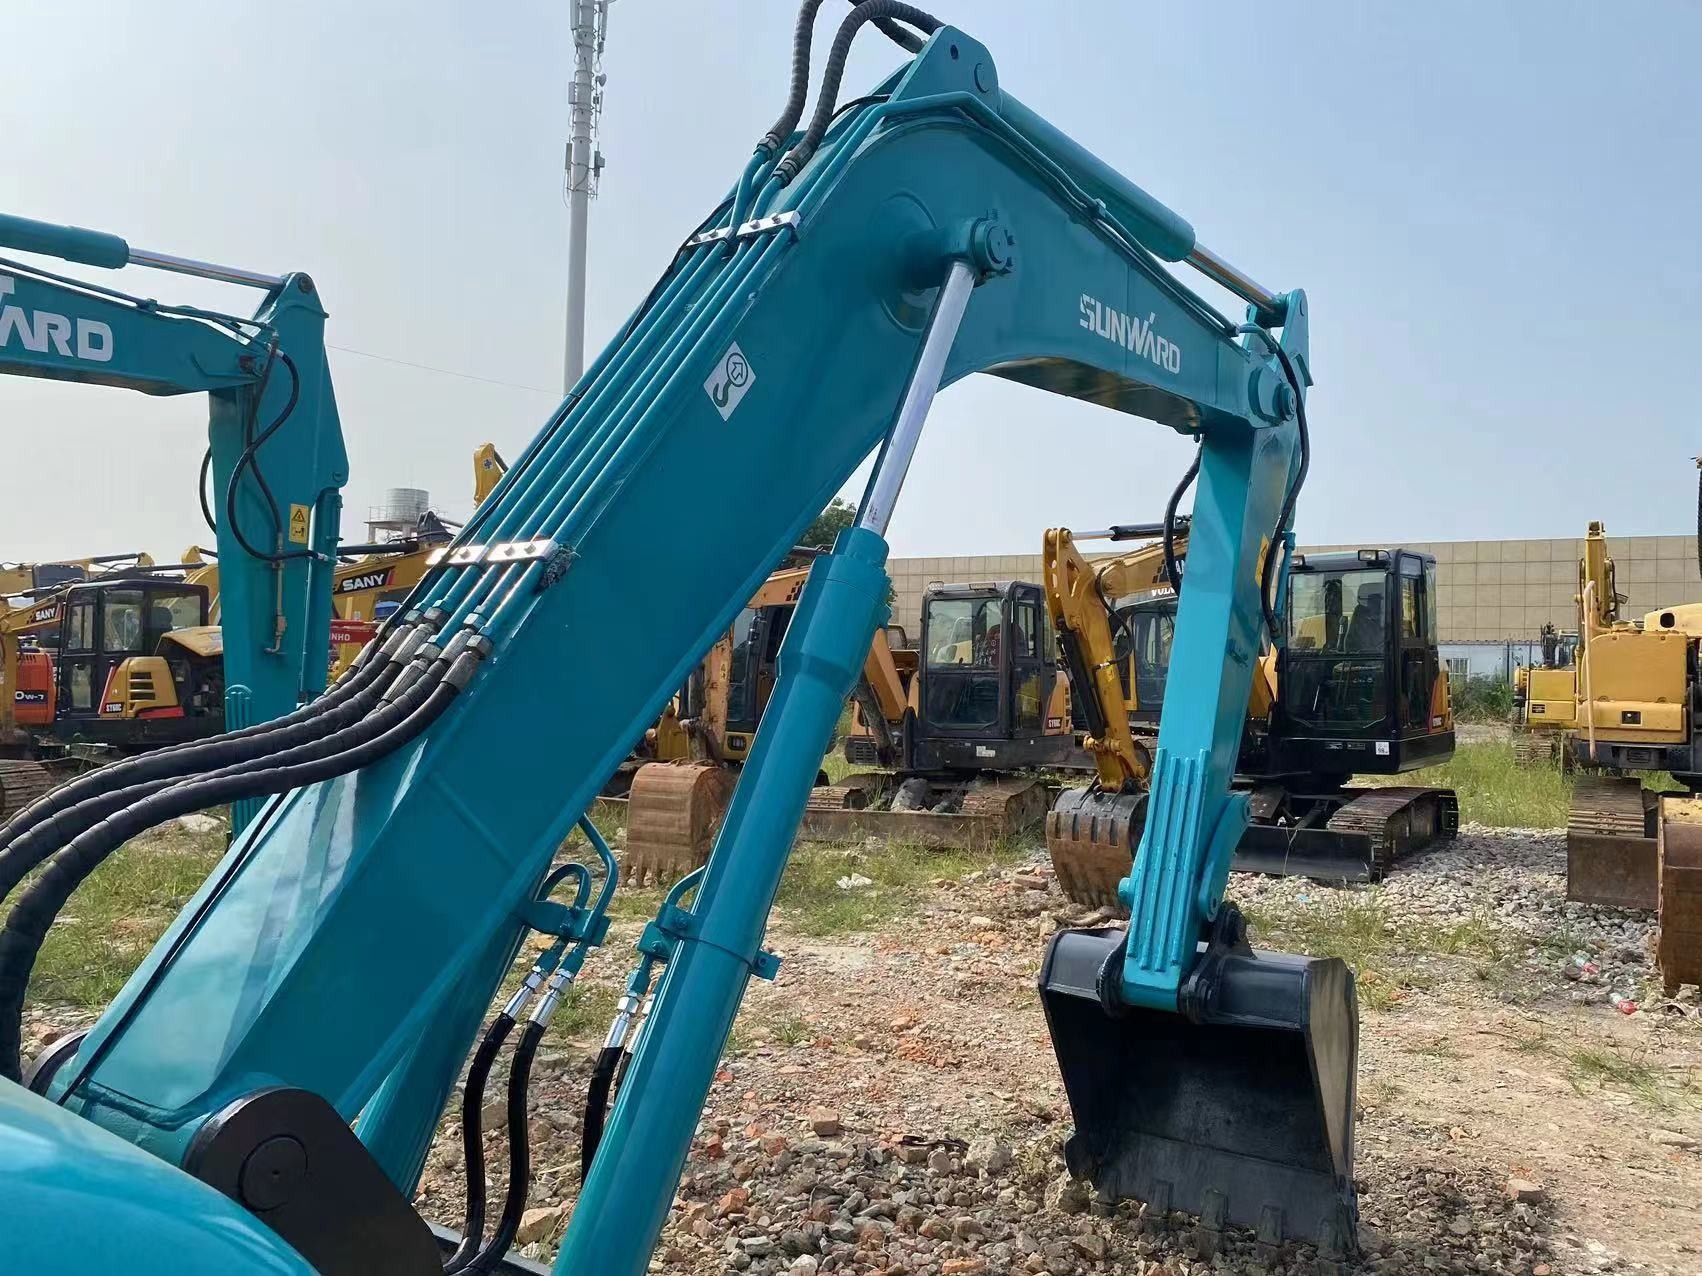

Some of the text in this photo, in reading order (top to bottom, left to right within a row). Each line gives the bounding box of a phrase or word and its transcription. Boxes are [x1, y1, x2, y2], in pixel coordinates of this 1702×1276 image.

[0, 274, 113, 362] ARD
[1080, 293, 1180, 374] SUNWARD
[342, 573, 385, 592] SANY
[35, 607, 56, 621] SANY
